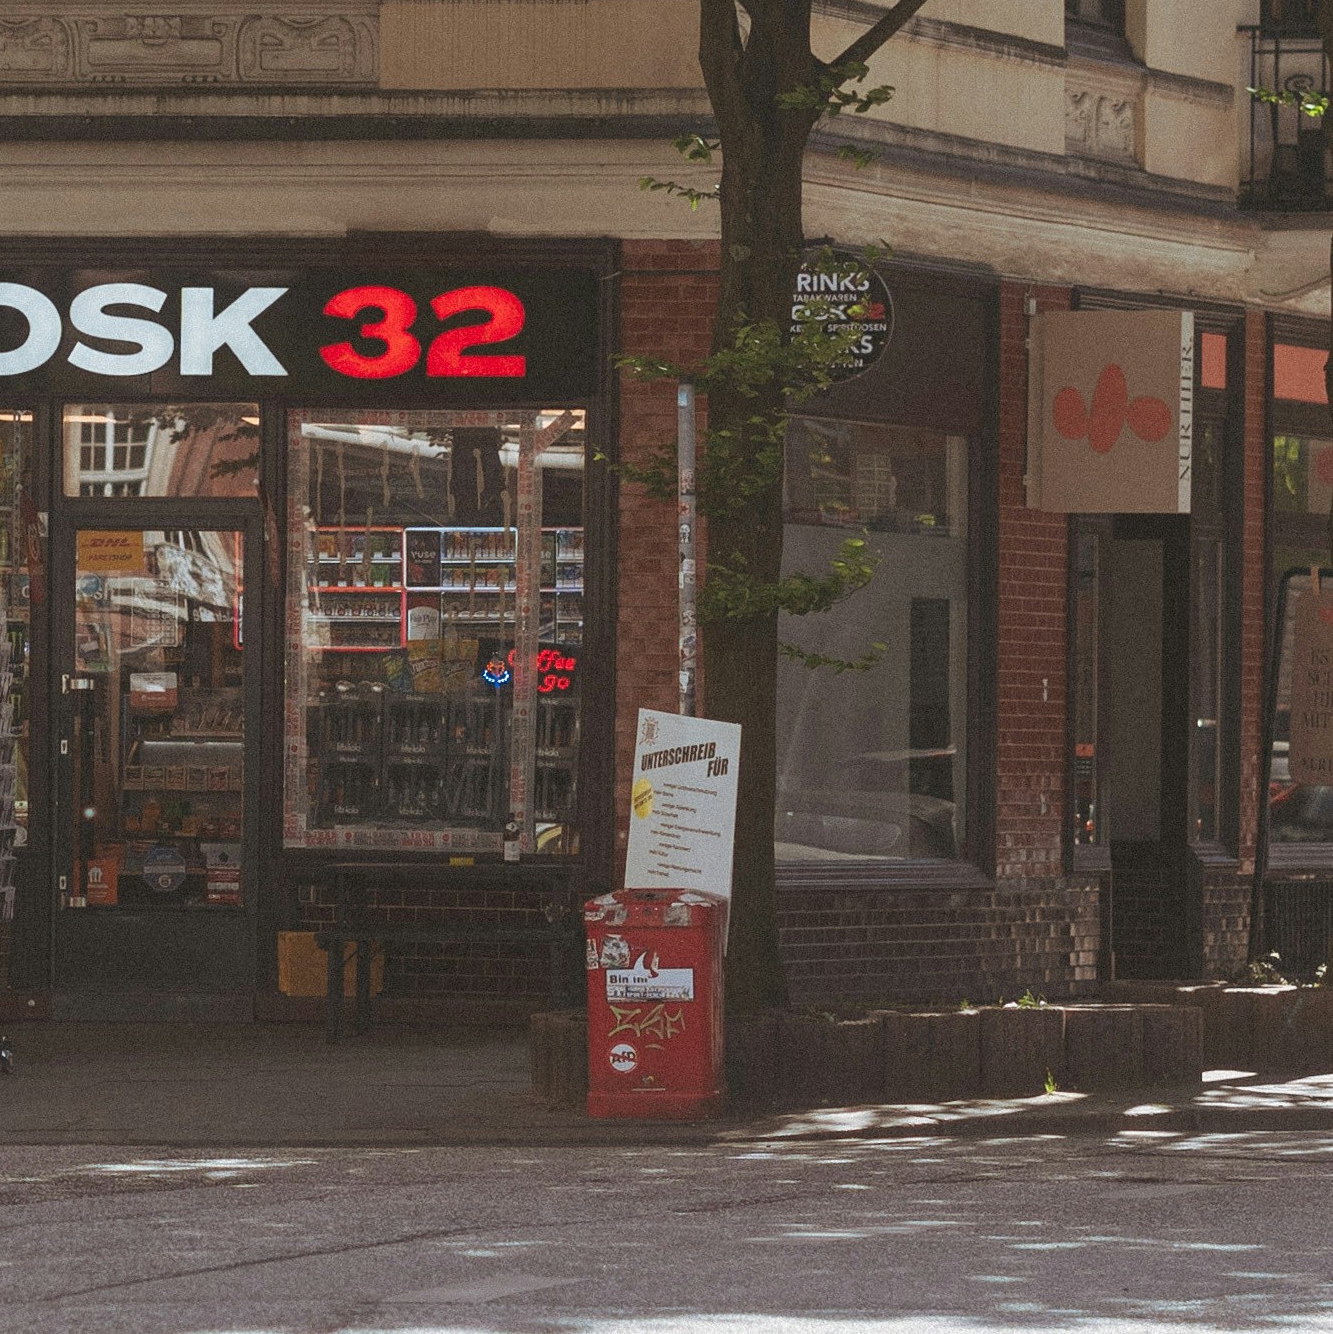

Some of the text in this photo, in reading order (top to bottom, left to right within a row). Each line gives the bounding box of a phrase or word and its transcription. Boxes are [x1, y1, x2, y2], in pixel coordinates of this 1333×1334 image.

[796, 272, 870, 292] RINKS
[318, 283, 527, 379] 32
[537, 674, 571, 693] go
[640, 741, 717, 772] UNTERSCHREIB
[706, 756, 730, 778] FÜR
[609, 974, 629, 984] Bin
